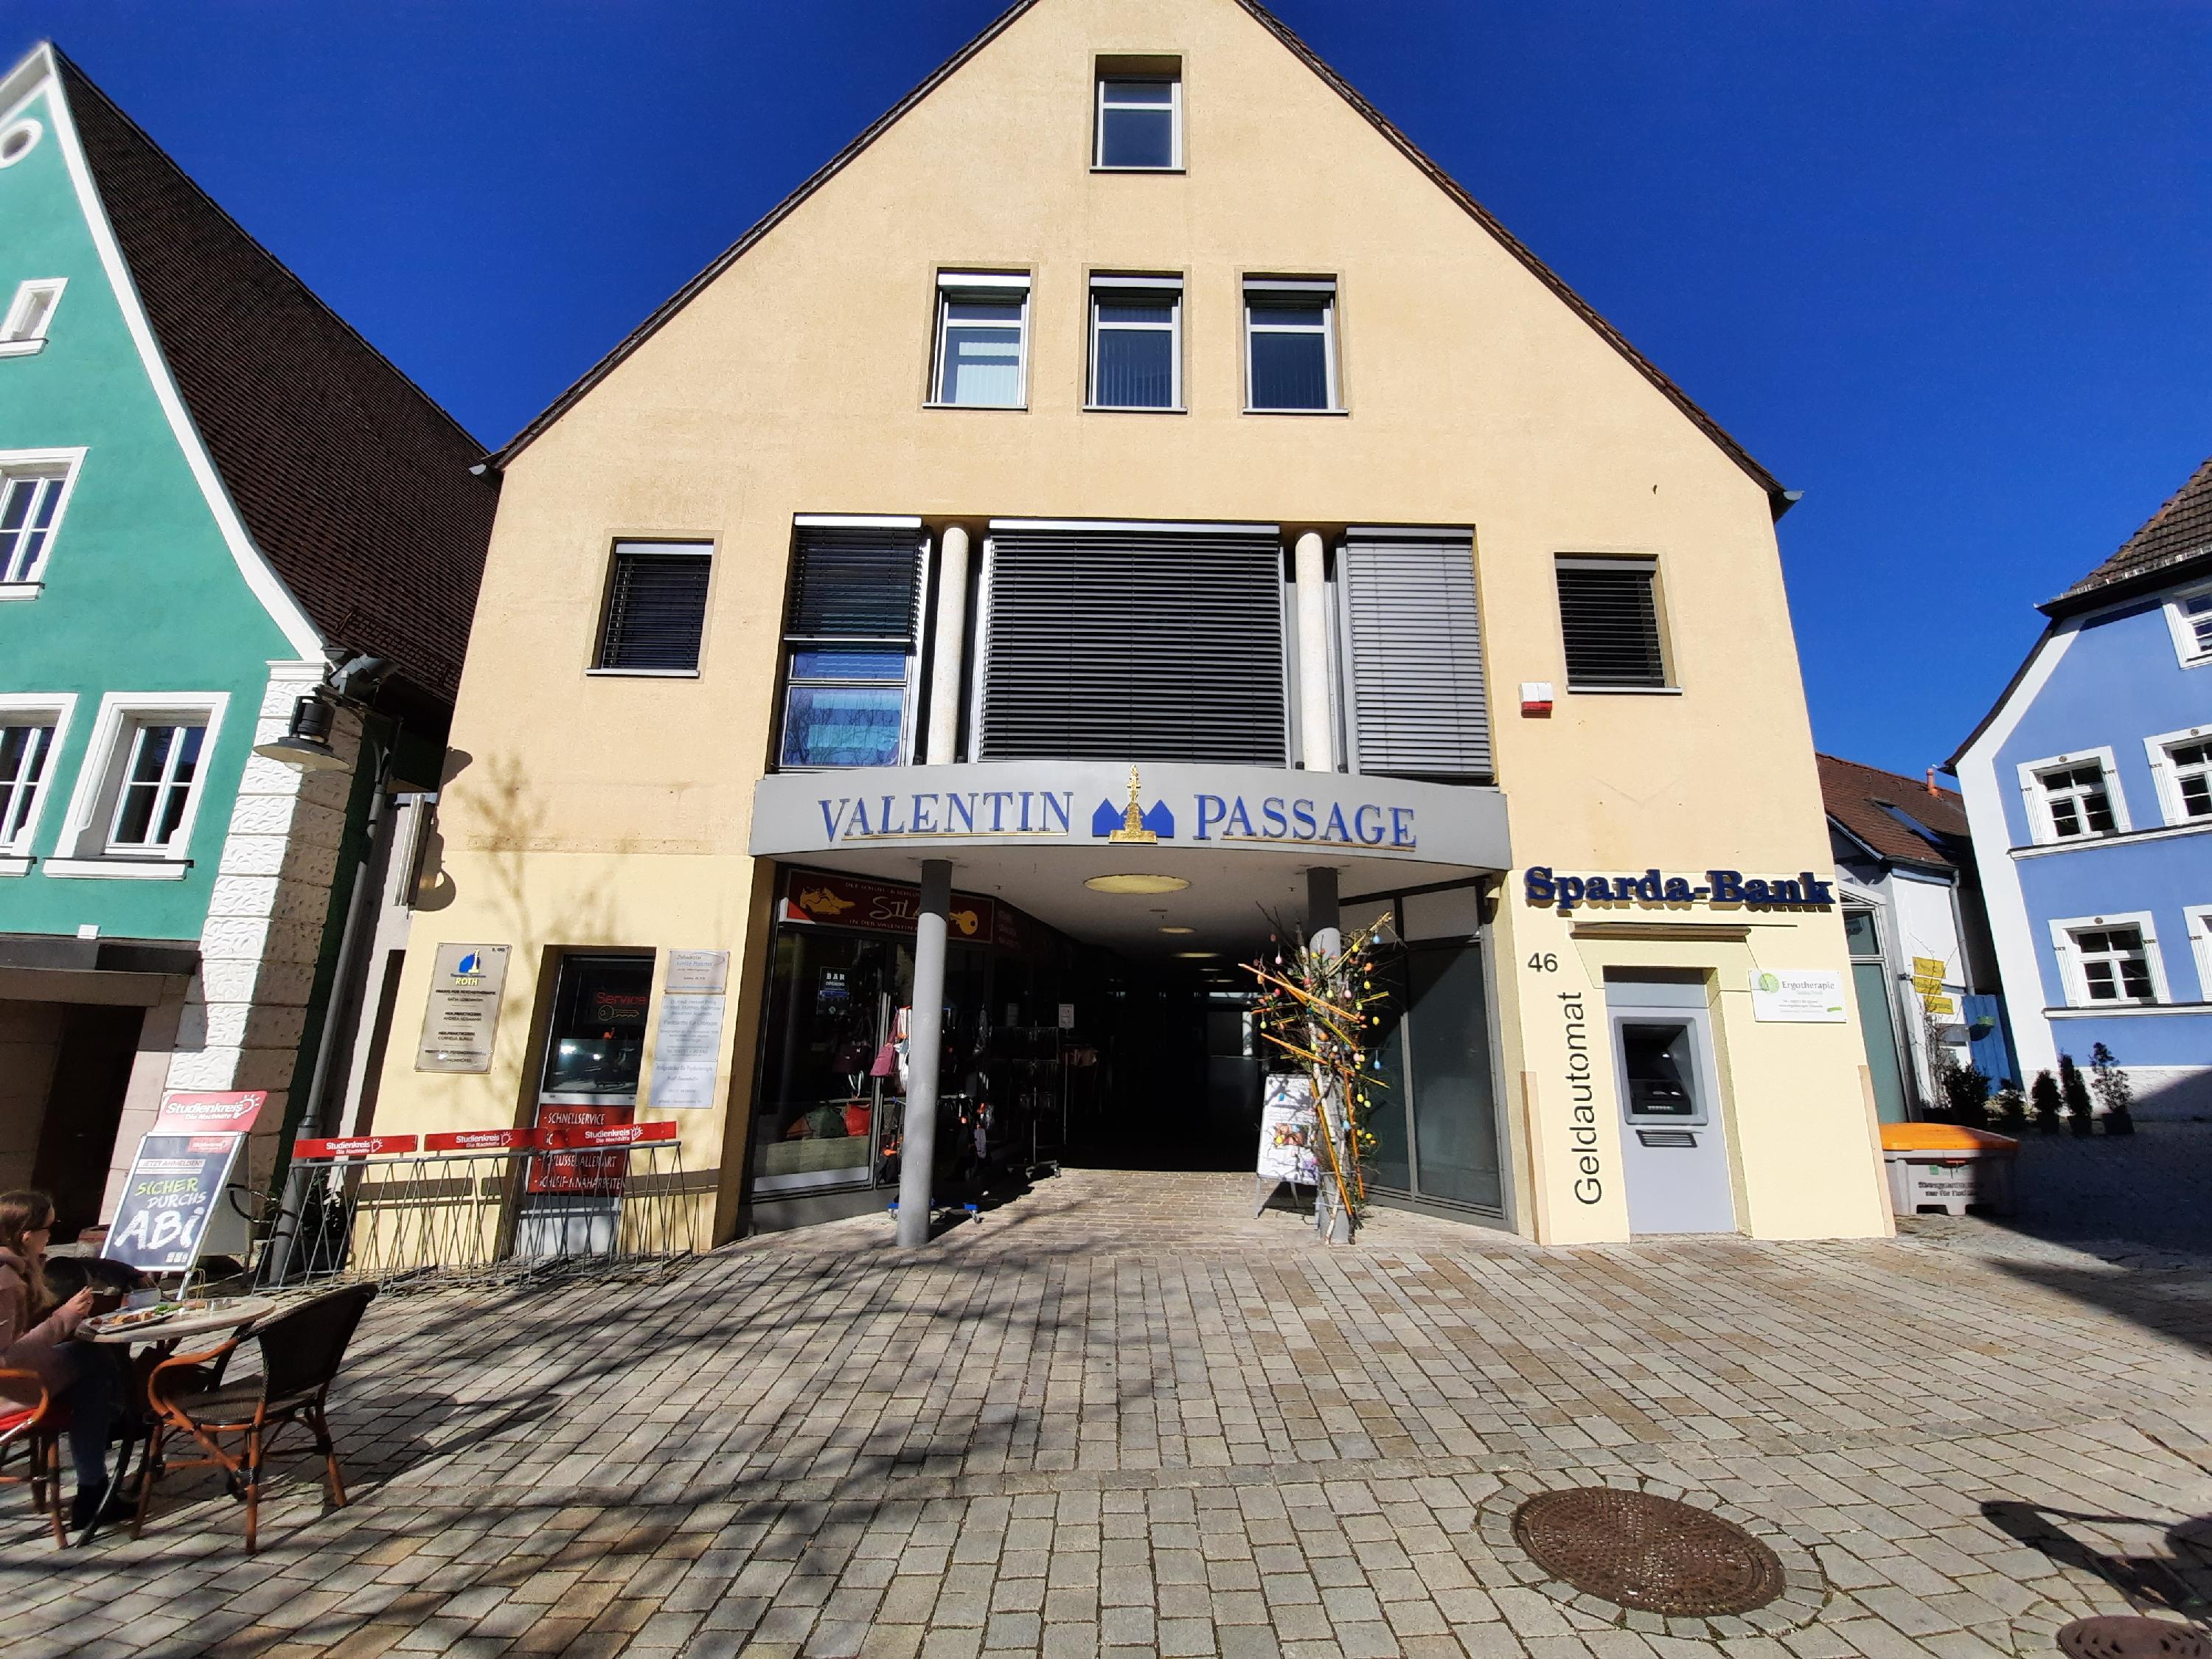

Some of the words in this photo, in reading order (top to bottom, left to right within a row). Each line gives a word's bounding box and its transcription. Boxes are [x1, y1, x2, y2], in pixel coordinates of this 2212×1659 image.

[818, 791, 1074, 842] VALENTIN
[1192, 794, 1416, 847] PASSAGE
[1523, 866, 1836, 909] Sparda-Bank
[1527, 952, 1558, 973] 46
[455, 978, 479, 986] ROTH
[826, 973, 845, 981] BAR
[1781, 981, 1834, 990] Ergotherapie
[597, 992, 647, 1004] Service
[1557, 991, 1602, 1205] Geldautomat
[165, 1102, 244, 1114] Studienkreis
[548, 1112, 605, 1125] SCHNELLSERVICE
[456, 1133, 500, 1144] Studienkreis
[585, 1128, 630, 1139] Studienkreis
[326, 1141, 370, 1150] Studienkreis
[147, 1192, 207, 1209] DURCHS
